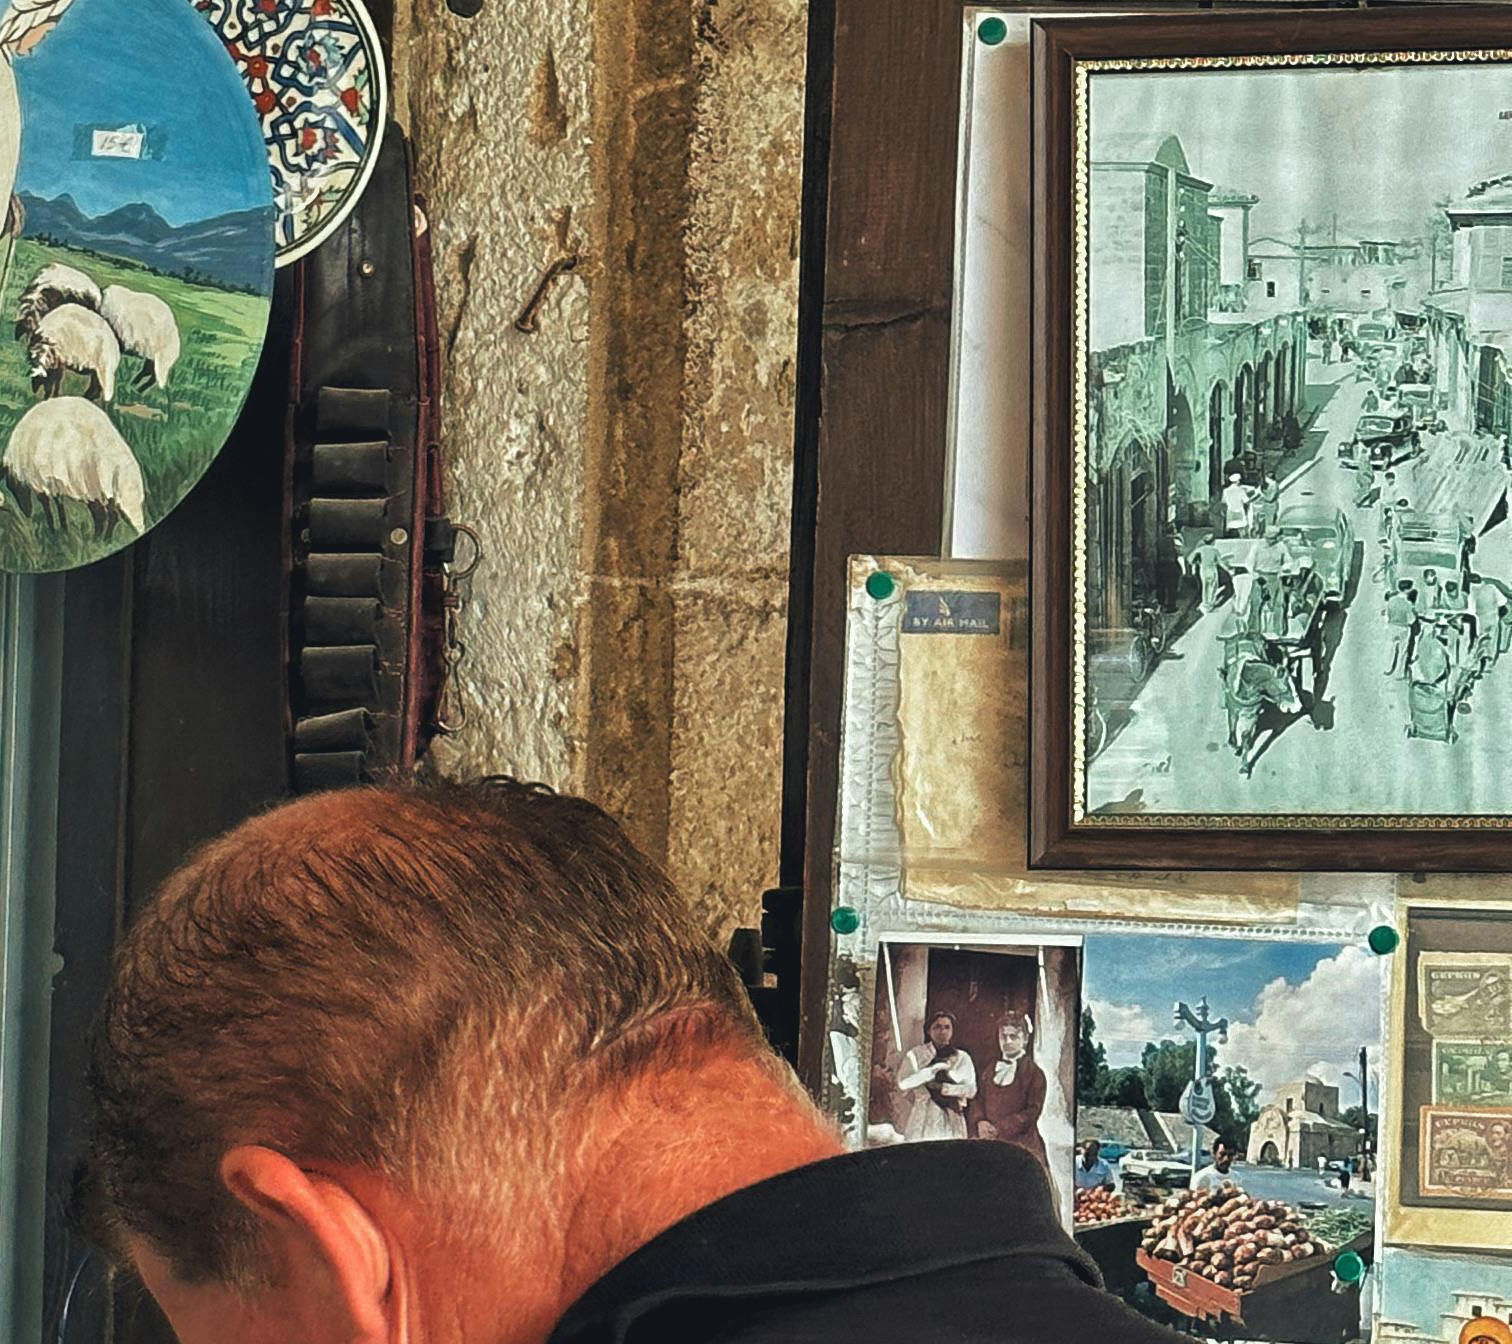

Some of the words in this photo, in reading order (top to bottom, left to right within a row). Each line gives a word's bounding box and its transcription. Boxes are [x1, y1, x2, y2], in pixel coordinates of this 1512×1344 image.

[912, 617, 929, 628] BY
[934, 617, 954, 627] AIR
[959, 617, 989, 629] MAIL
